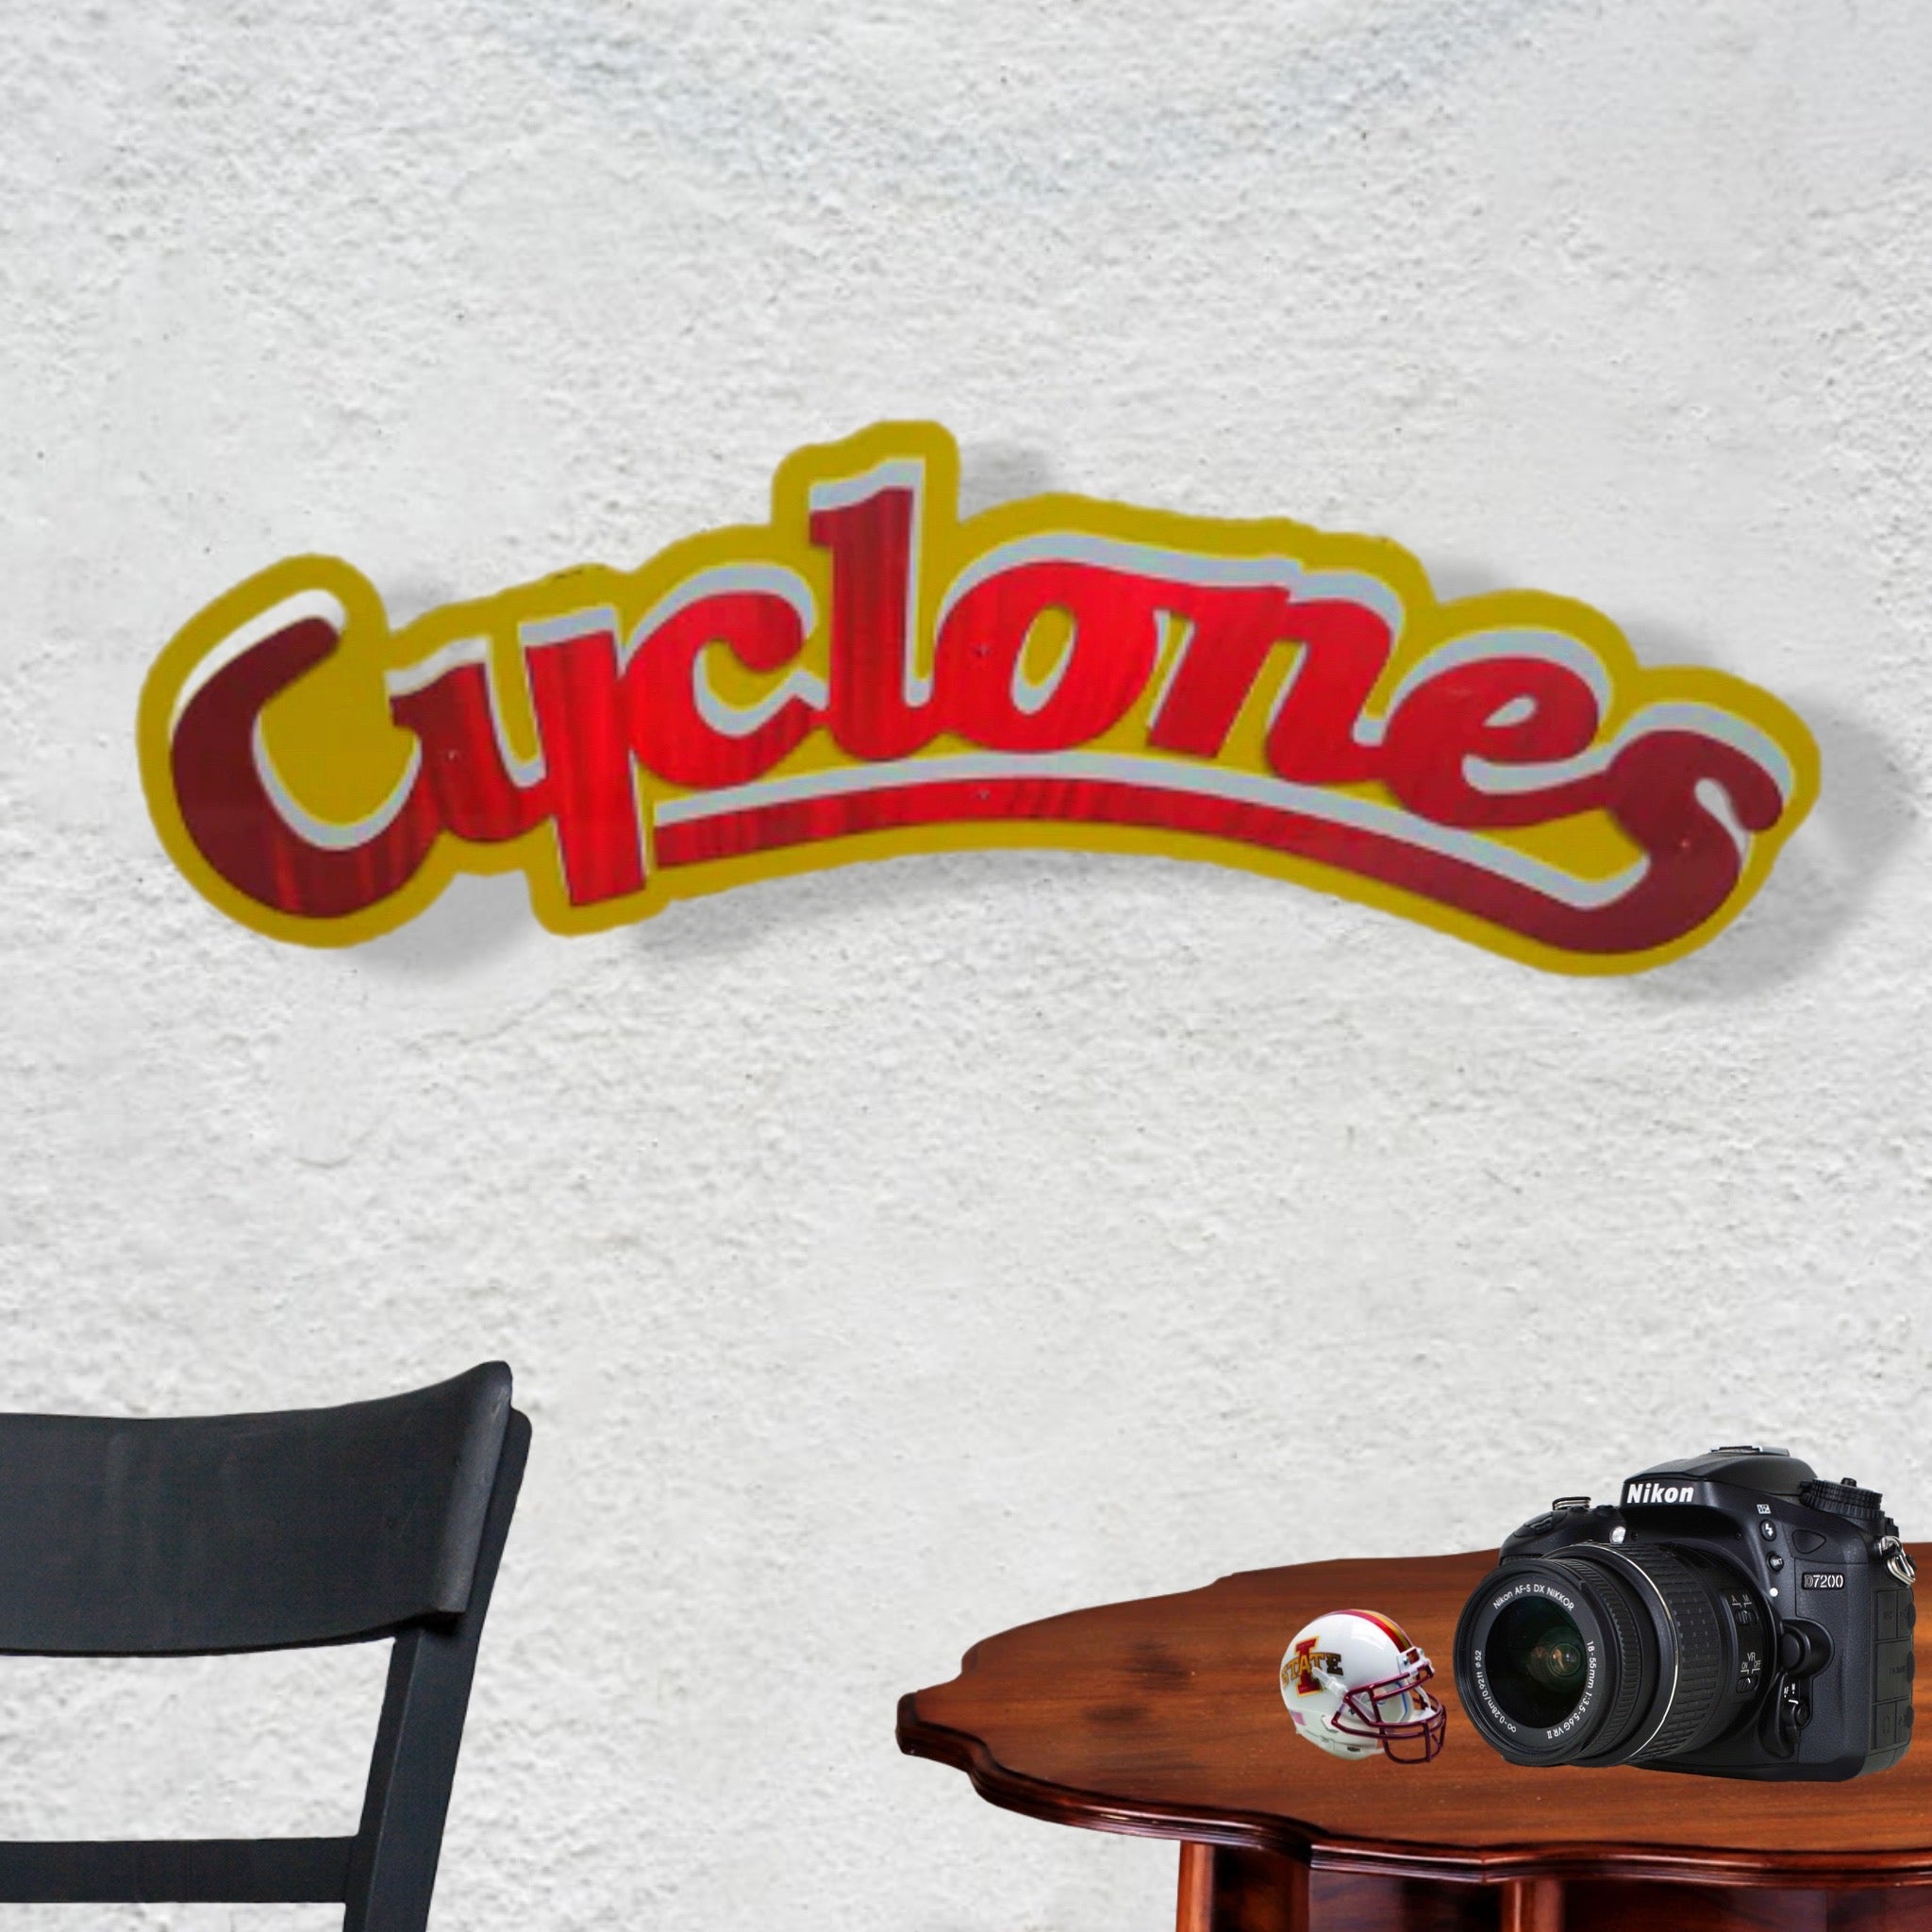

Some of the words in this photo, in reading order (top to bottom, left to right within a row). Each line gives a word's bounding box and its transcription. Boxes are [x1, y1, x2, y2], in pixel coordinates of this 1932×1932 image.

[172, 457, 1793, 954] Cyclones
[1626, 1483, 1694, 1504] Nikon
[1804, 1574, 1844, 1589] D7200
[1492, 1591, 1513, 1609] Nikon
[1514, 1584, 1531, 1595] AF-S
[1533, 1584, 1545, 1594] DX
[1546, 1587, 1574, 1611] NIKKOR
[1741, 1661, 1749, 1670] ON
[1747, 1652, 1756, 1662] VR
[1281, 1652, 1344, 1688] STATE
